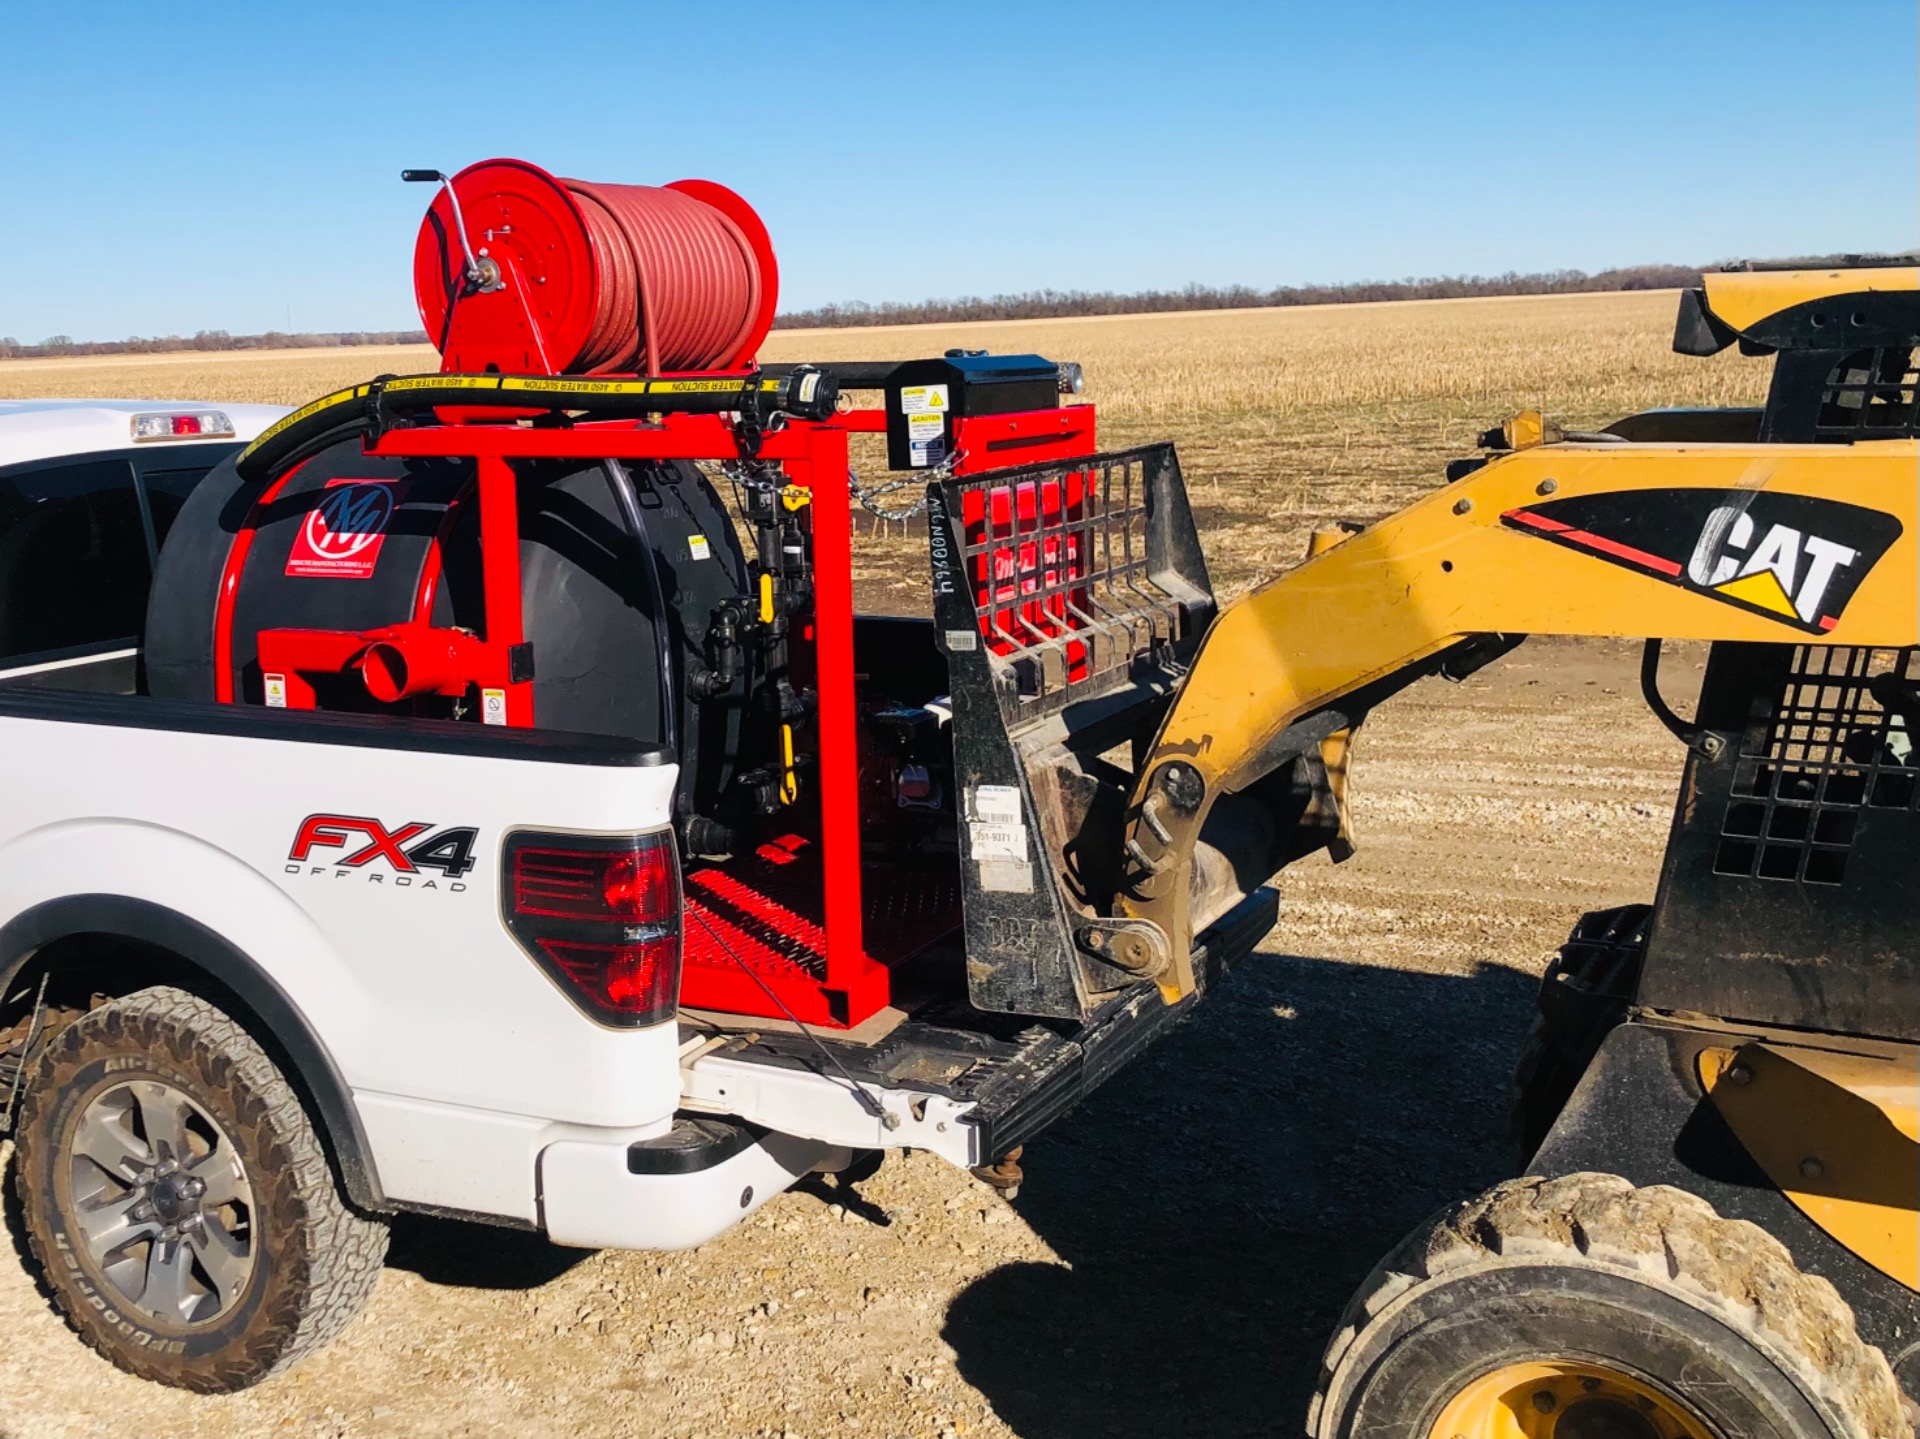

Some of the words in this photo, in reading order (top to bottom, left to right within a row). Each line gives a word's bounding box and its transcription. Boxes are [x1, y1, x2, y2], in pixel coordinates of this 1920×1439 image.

[415, 378, 444, 388] WATER
[523, 380, 559, 390] SUCTION
[559, 381, 589, 392] WATER
[671, 381, 710, 391] SUCTION
[710, 380, 743, 390] WATER
[916, 414, 941, 423] CAUTION
[1687, 505, 1858, 625] CAT
[287, 812, 480, 879] FX4
[284, 864, 351, 879] OFF
[368, 873, 467, 893] ROAD
